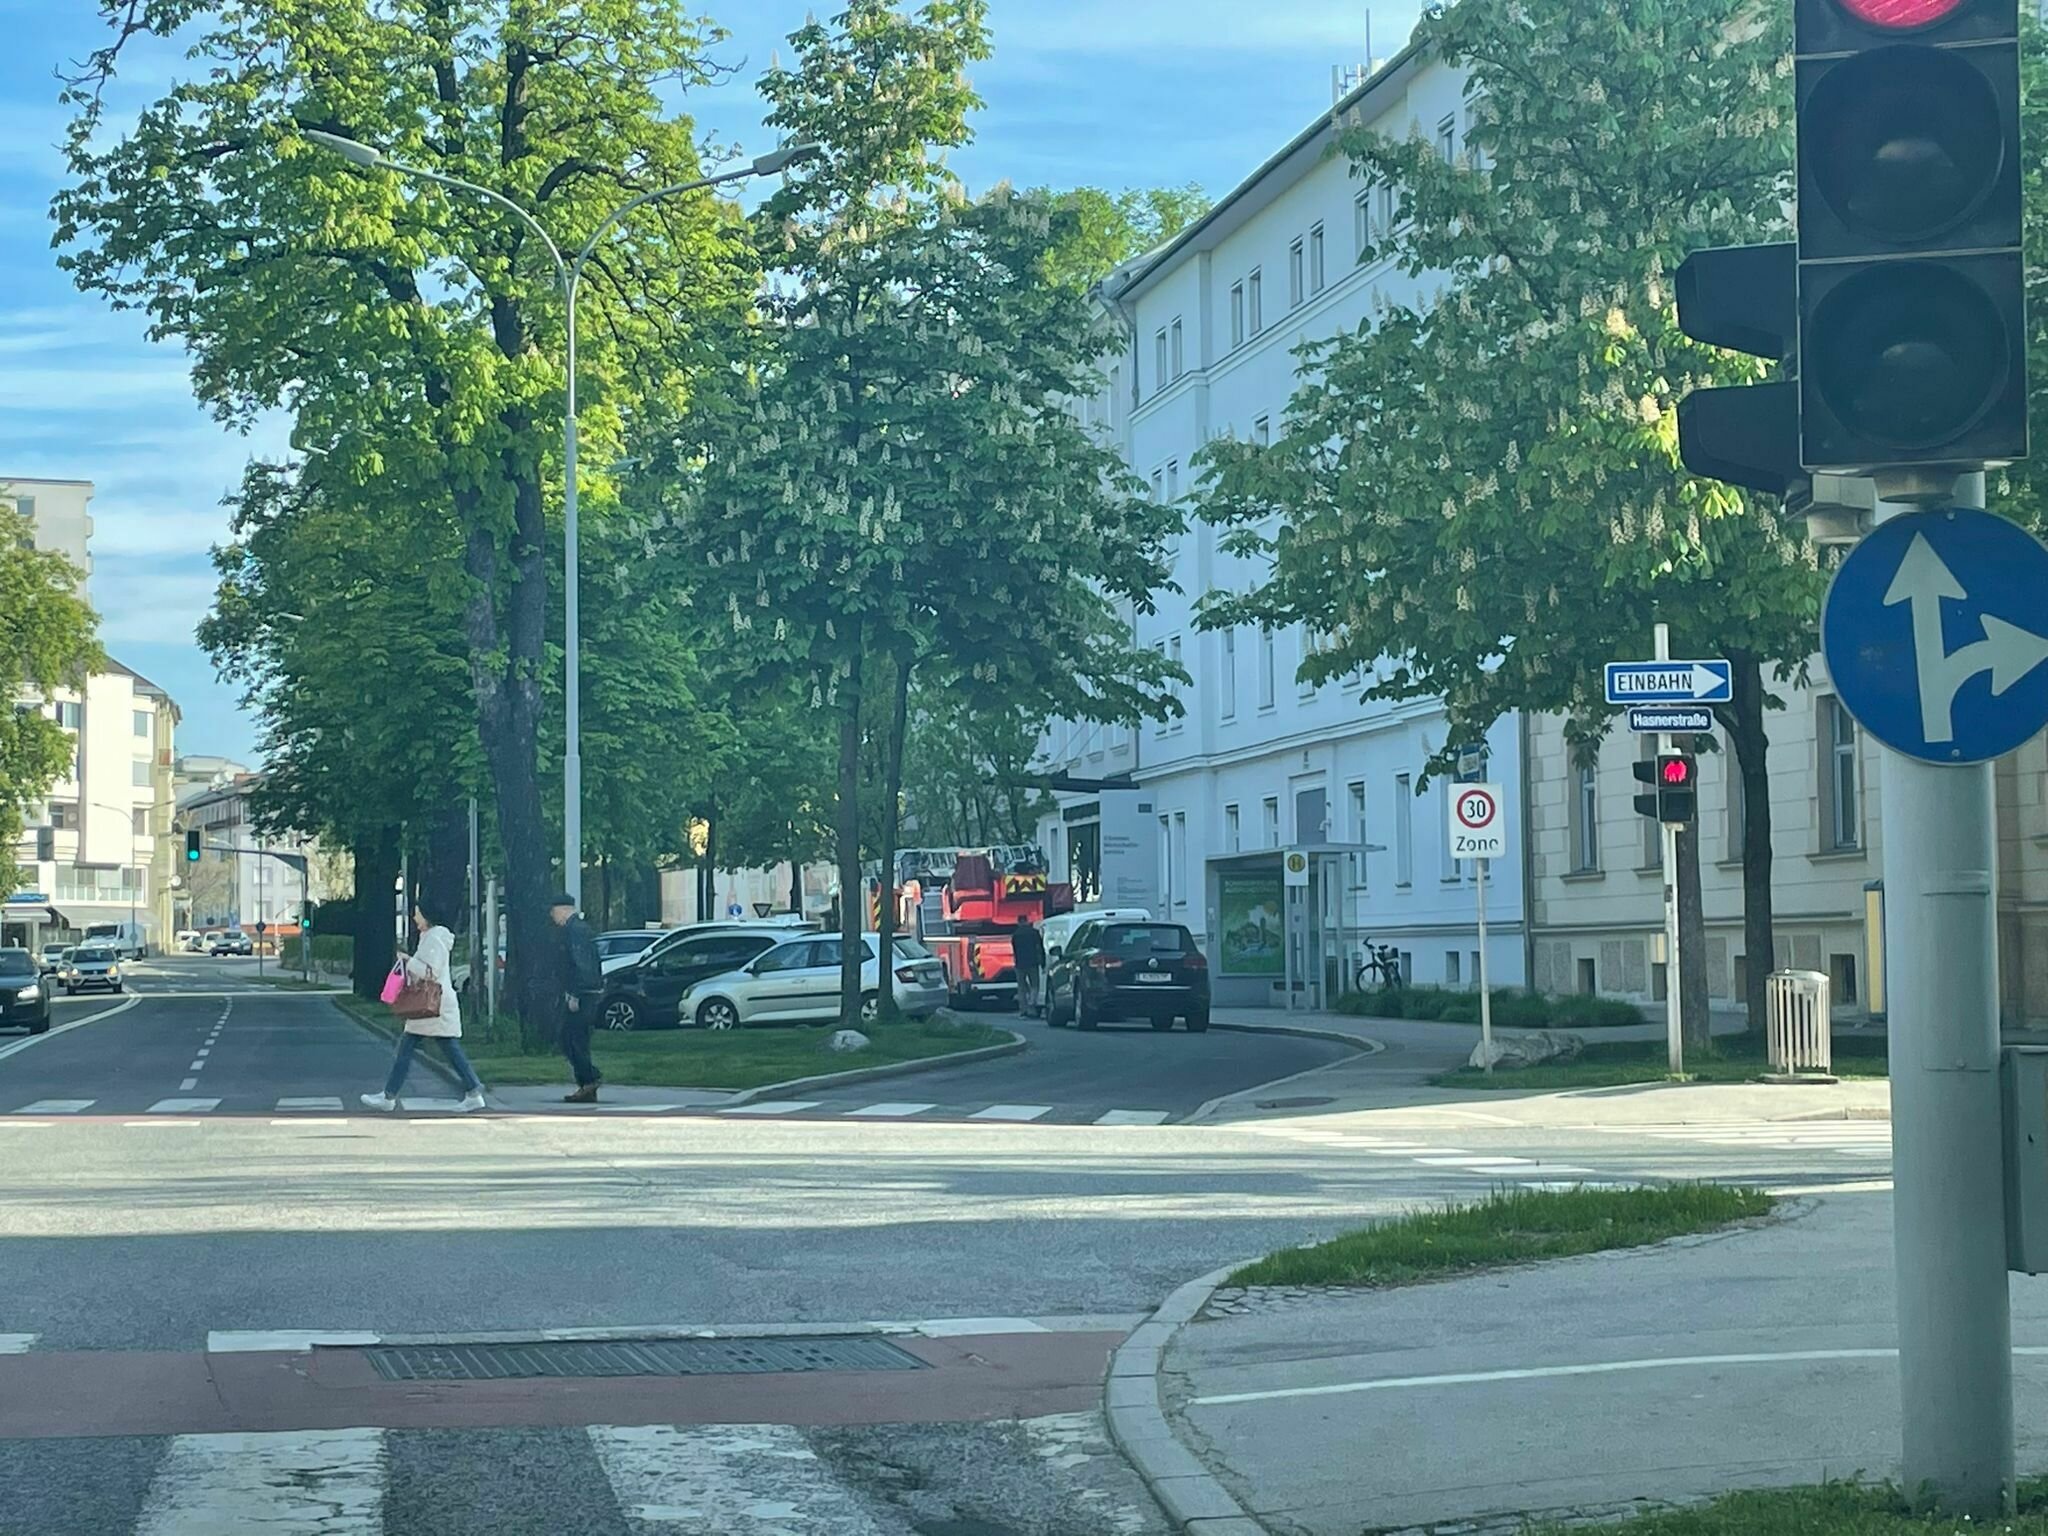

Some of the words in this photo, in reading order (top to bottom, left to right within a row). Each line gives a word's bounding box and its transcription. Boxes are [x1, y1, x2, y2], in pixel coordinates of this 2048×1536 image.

[1618, 673, 1692, 691] EINBAHN
[1633, 713, 1708, 727] Hasnerstraße
[1466, 799, 1486, 818] 30
